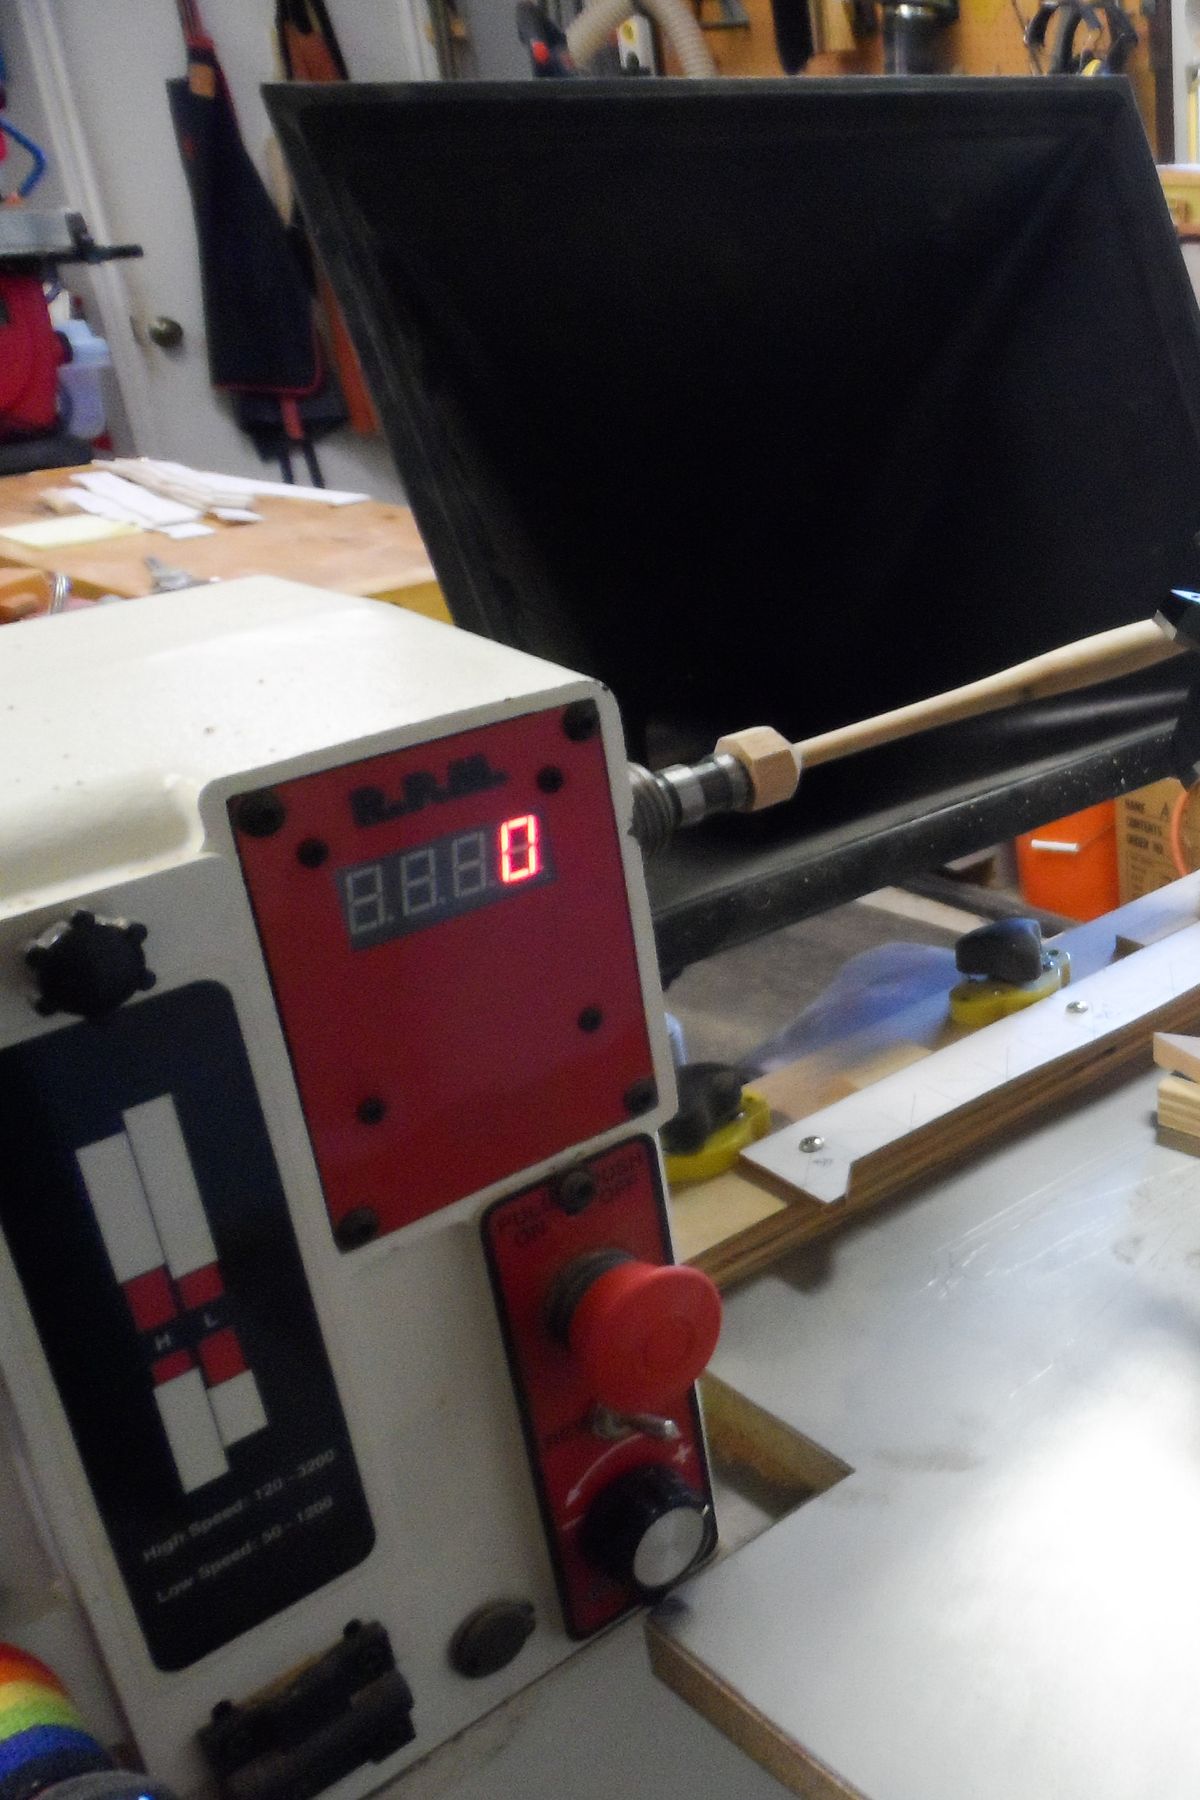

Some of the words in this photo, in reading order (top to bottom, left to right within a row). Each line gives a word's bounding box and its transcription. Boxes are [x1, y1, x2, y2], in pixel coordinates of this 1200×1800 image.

[500, 814, 539, 883] 0
[155, 1333, 172, 1352] H
[203, 1312, 219, 1328] L
[143, 1532, 187, 1564] High
[156, 1576, 195, 1603] Low
